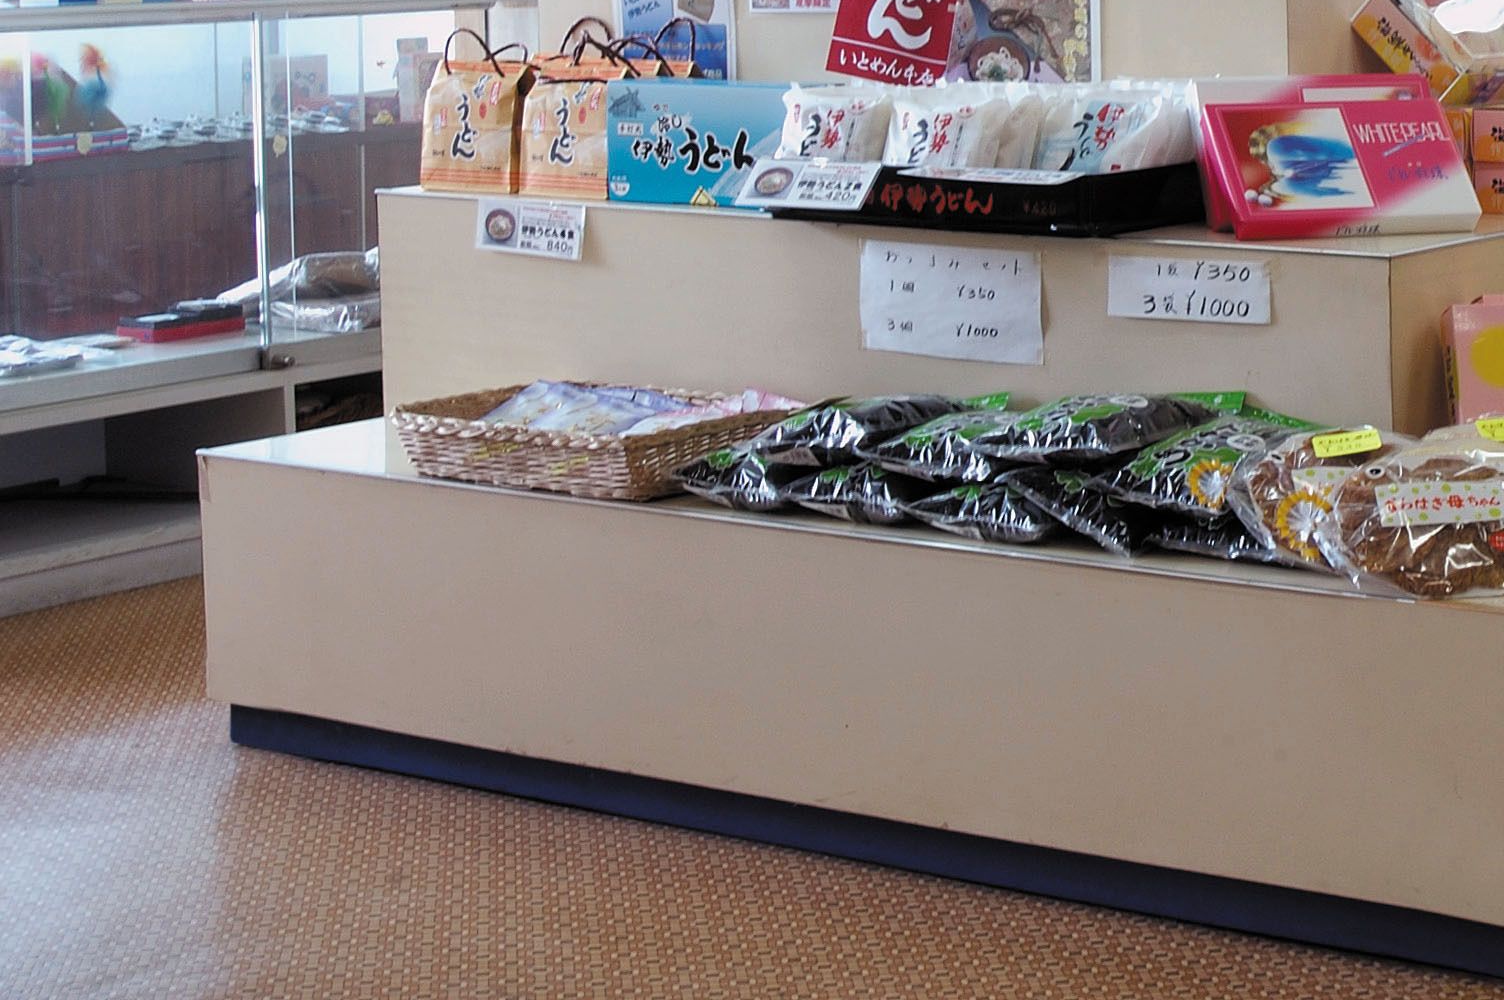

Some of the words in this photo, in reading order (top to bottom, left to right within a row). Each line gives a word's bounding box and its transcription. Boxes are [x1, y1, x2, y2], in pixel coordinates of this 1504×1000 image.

[452, 93, 477, 158] うどん
[549, 97, 575, 164] うどん
